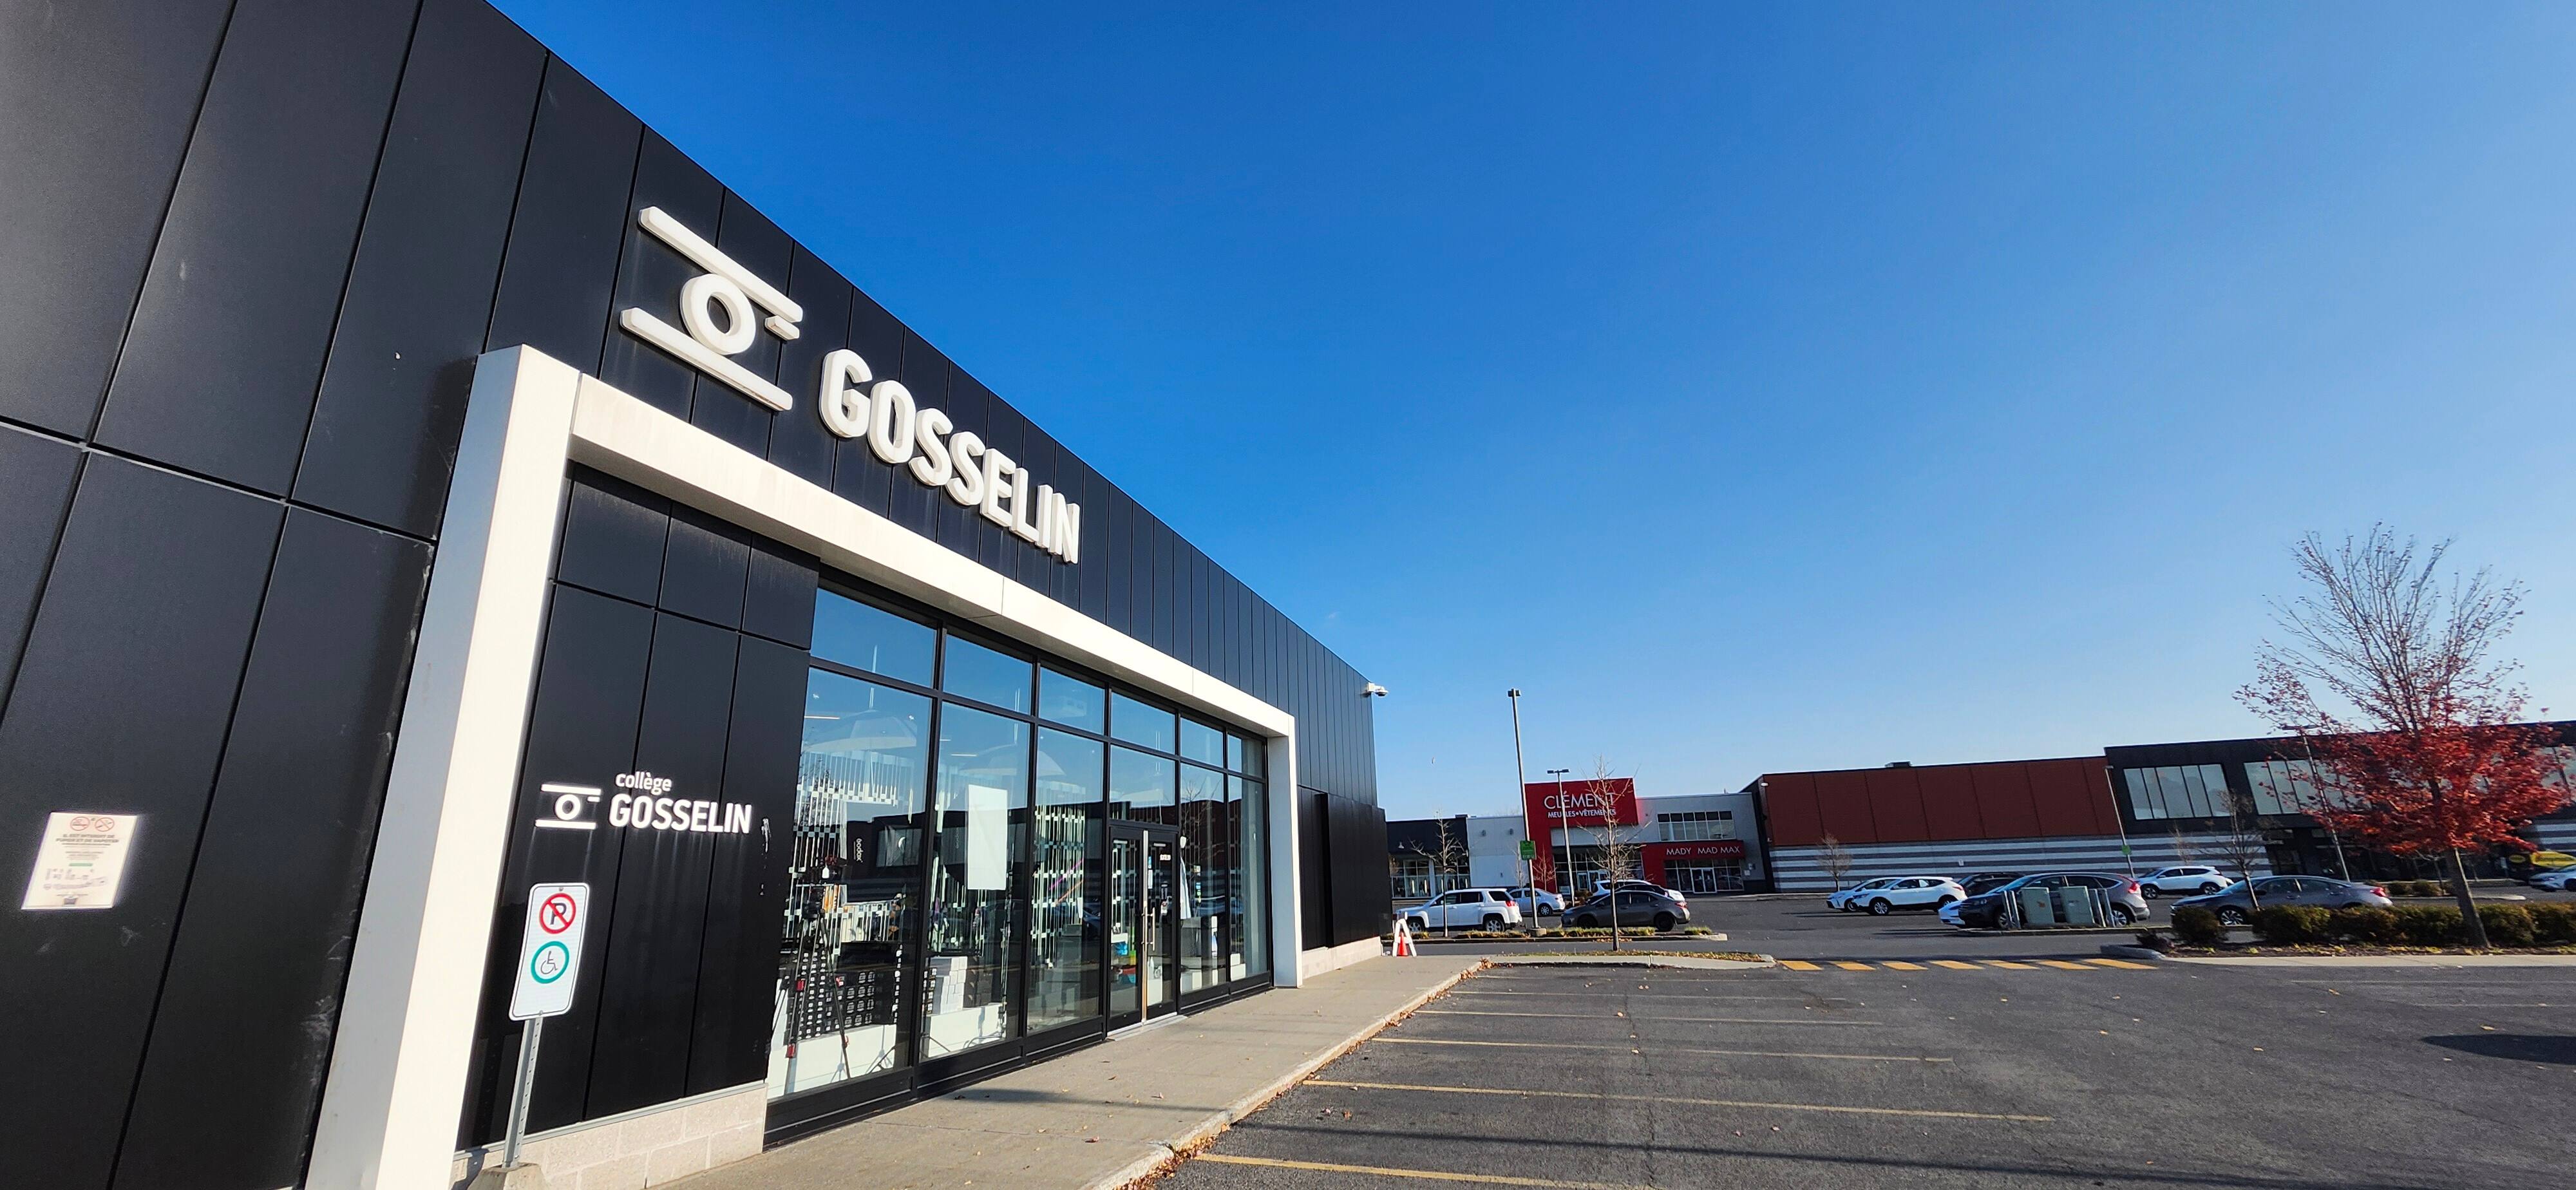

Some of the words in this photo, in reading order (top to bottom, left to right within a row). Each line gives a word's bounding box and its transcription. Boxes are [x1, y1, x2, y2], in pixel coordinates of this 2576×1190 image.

[819, 348, 1080, 564] GOSSELIN
[615, 771, 672, 796] collège
[608, 793, 752, 834] GOSSELIN
[1548, 810, 1576, 818] MEULES
[1666, 847, 1691, 855] MADY
[1698, 846, 1718, 855] MAD
[1720, 845, 1741, 854] MAX
